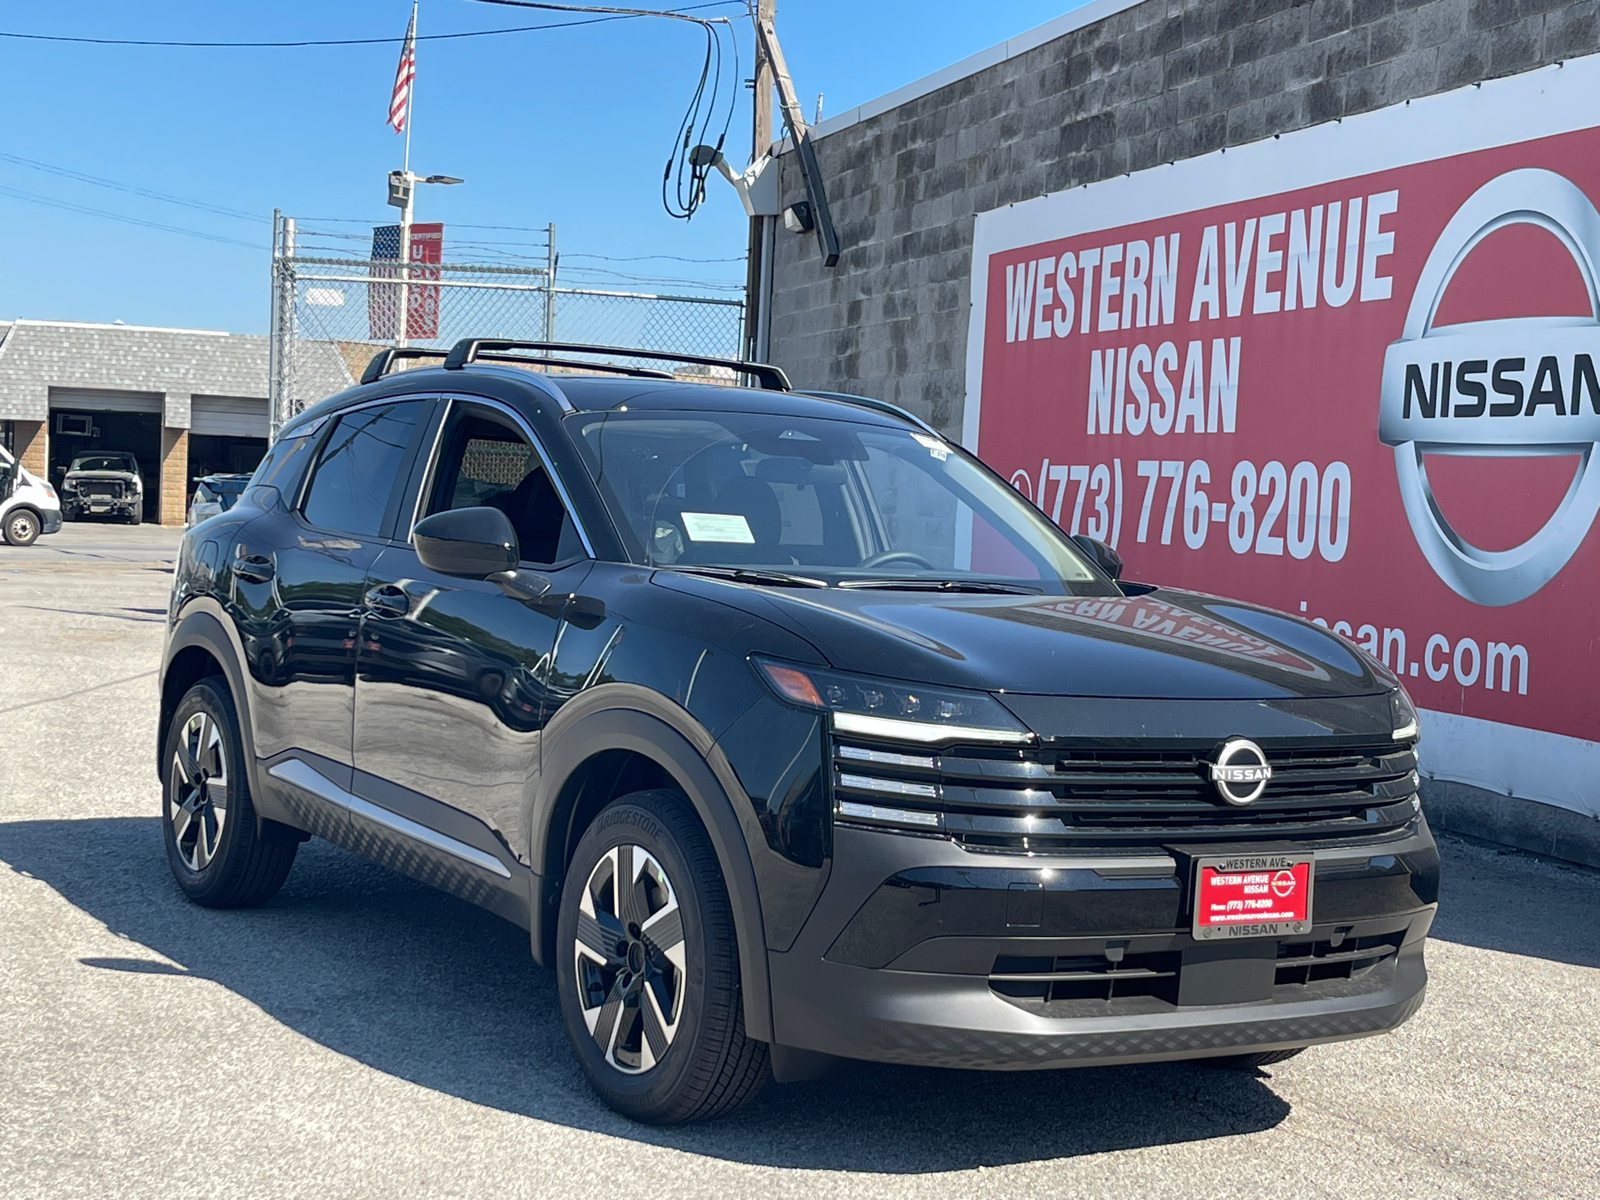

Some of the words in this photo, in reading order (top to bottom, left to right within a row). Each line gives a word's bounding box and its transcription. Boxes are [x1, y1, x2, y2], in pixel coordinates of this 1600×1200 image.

[1005, 233, 1180, 343] WESTERN
[1189, 189, 1399, 322] AVENUE
[1086, 336, 1242, 435] NISSAN
[1402, 353, 1600, 419] NISSAN
[1136, 459, 1351, 562] 776-8200
[1213, 767, 1271, 780] NISSAN
[596, 809, 663, 842] BRIDGESTONE
[1226, 858, 1267, 869] WESTERN
[1210, 876, 1242, 886] WESTERN
[1243, 874, 1270, 884] AVENUE
[1244, 885, 1269, 894] NISSAN
[1226, 900, 1243, 911] (773)
[1244, 899, 1273, 909] 776-8200
[1229, 924, 1278, 936] NISSAN
